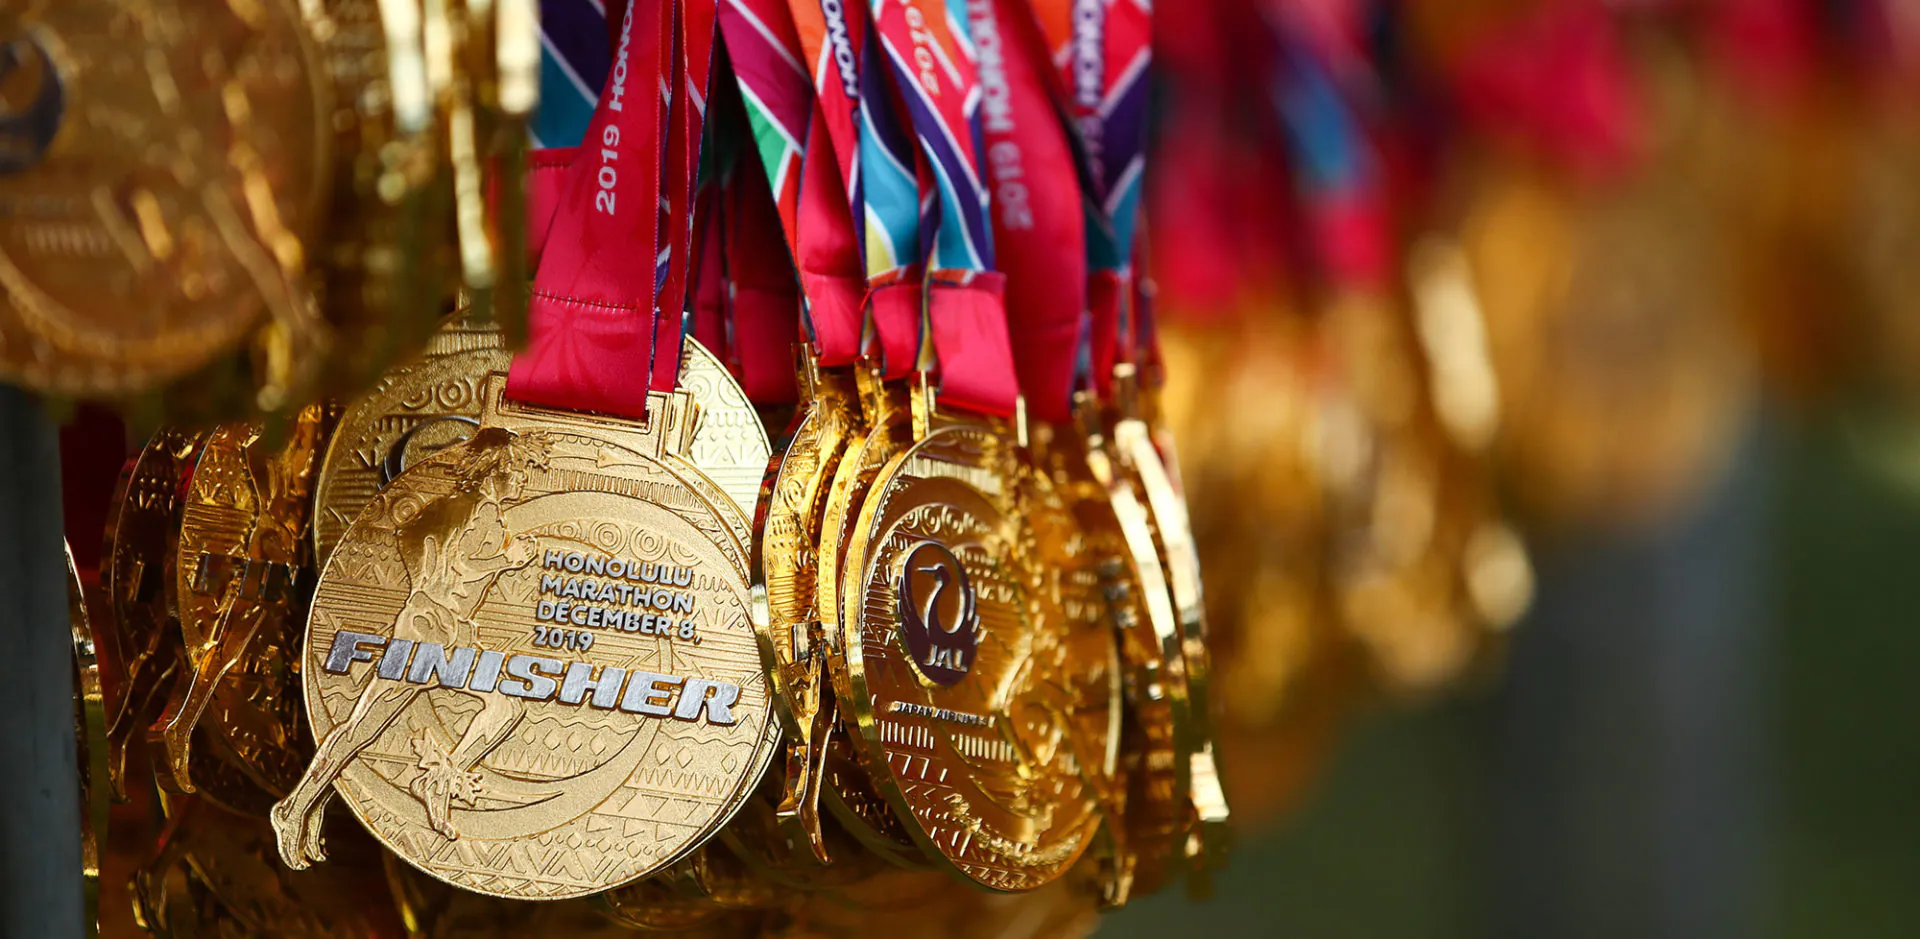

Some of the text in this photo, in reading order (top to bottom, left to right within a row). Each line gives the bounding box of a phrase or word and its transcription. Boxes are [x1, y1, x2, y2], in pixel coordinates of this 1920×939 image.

[905, 6, 940, 96] 2019
[595, 125, 620, 215] 2019
[989, 141, 1033, 230] 2019
[544, 549, 693, 588] HONOLULU
[540, 575, 694, 614] MARATHON
[533, 626, 593, 651] 2019
[536, 600, 702, 644] DECEMBER 8,
[325, 630, 742, 725] FINISHER
[923, 645, 968, 673] JAL
